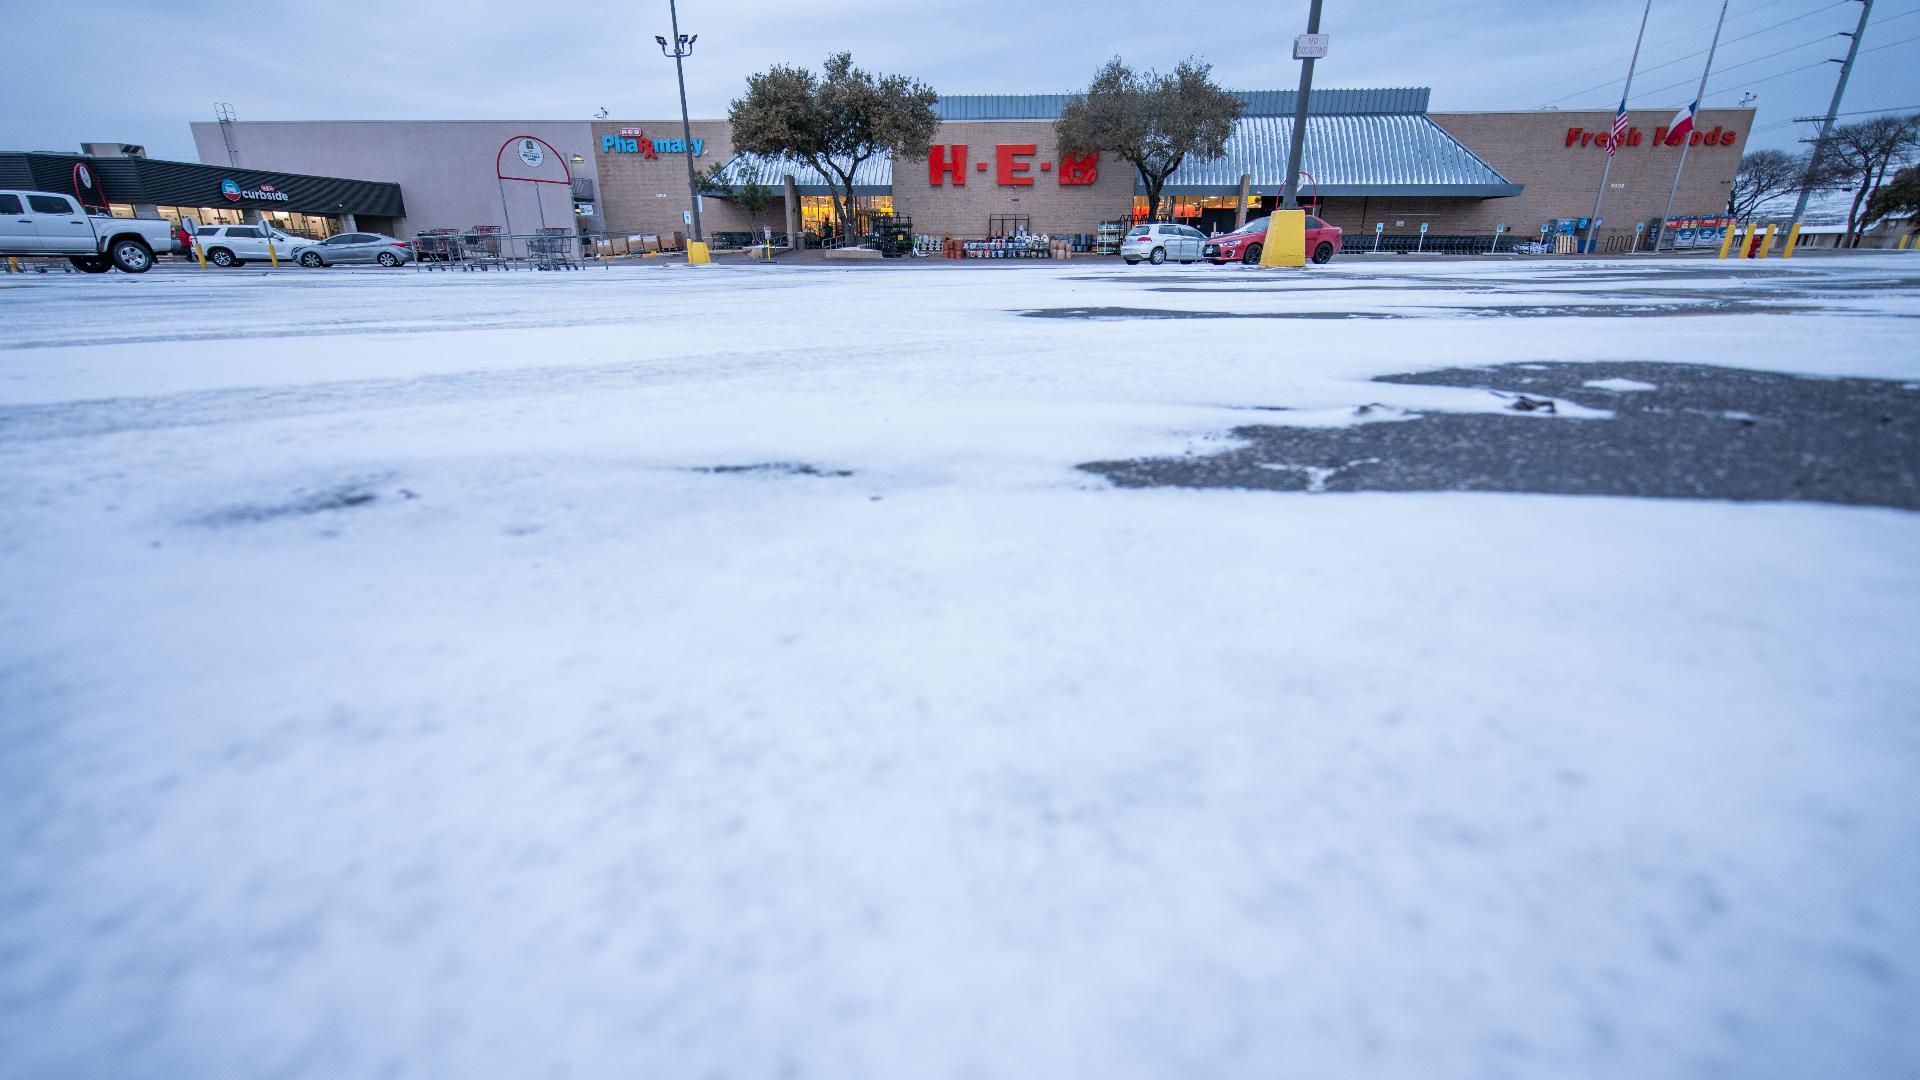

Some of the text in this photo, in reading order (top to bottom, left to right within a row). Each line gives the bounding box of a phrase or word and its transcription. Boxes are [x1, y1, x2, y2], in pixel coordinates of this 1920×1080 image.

[1565, 126, 1736, 147] Fresh Fods
[242, 189, 289, 201] curbside
